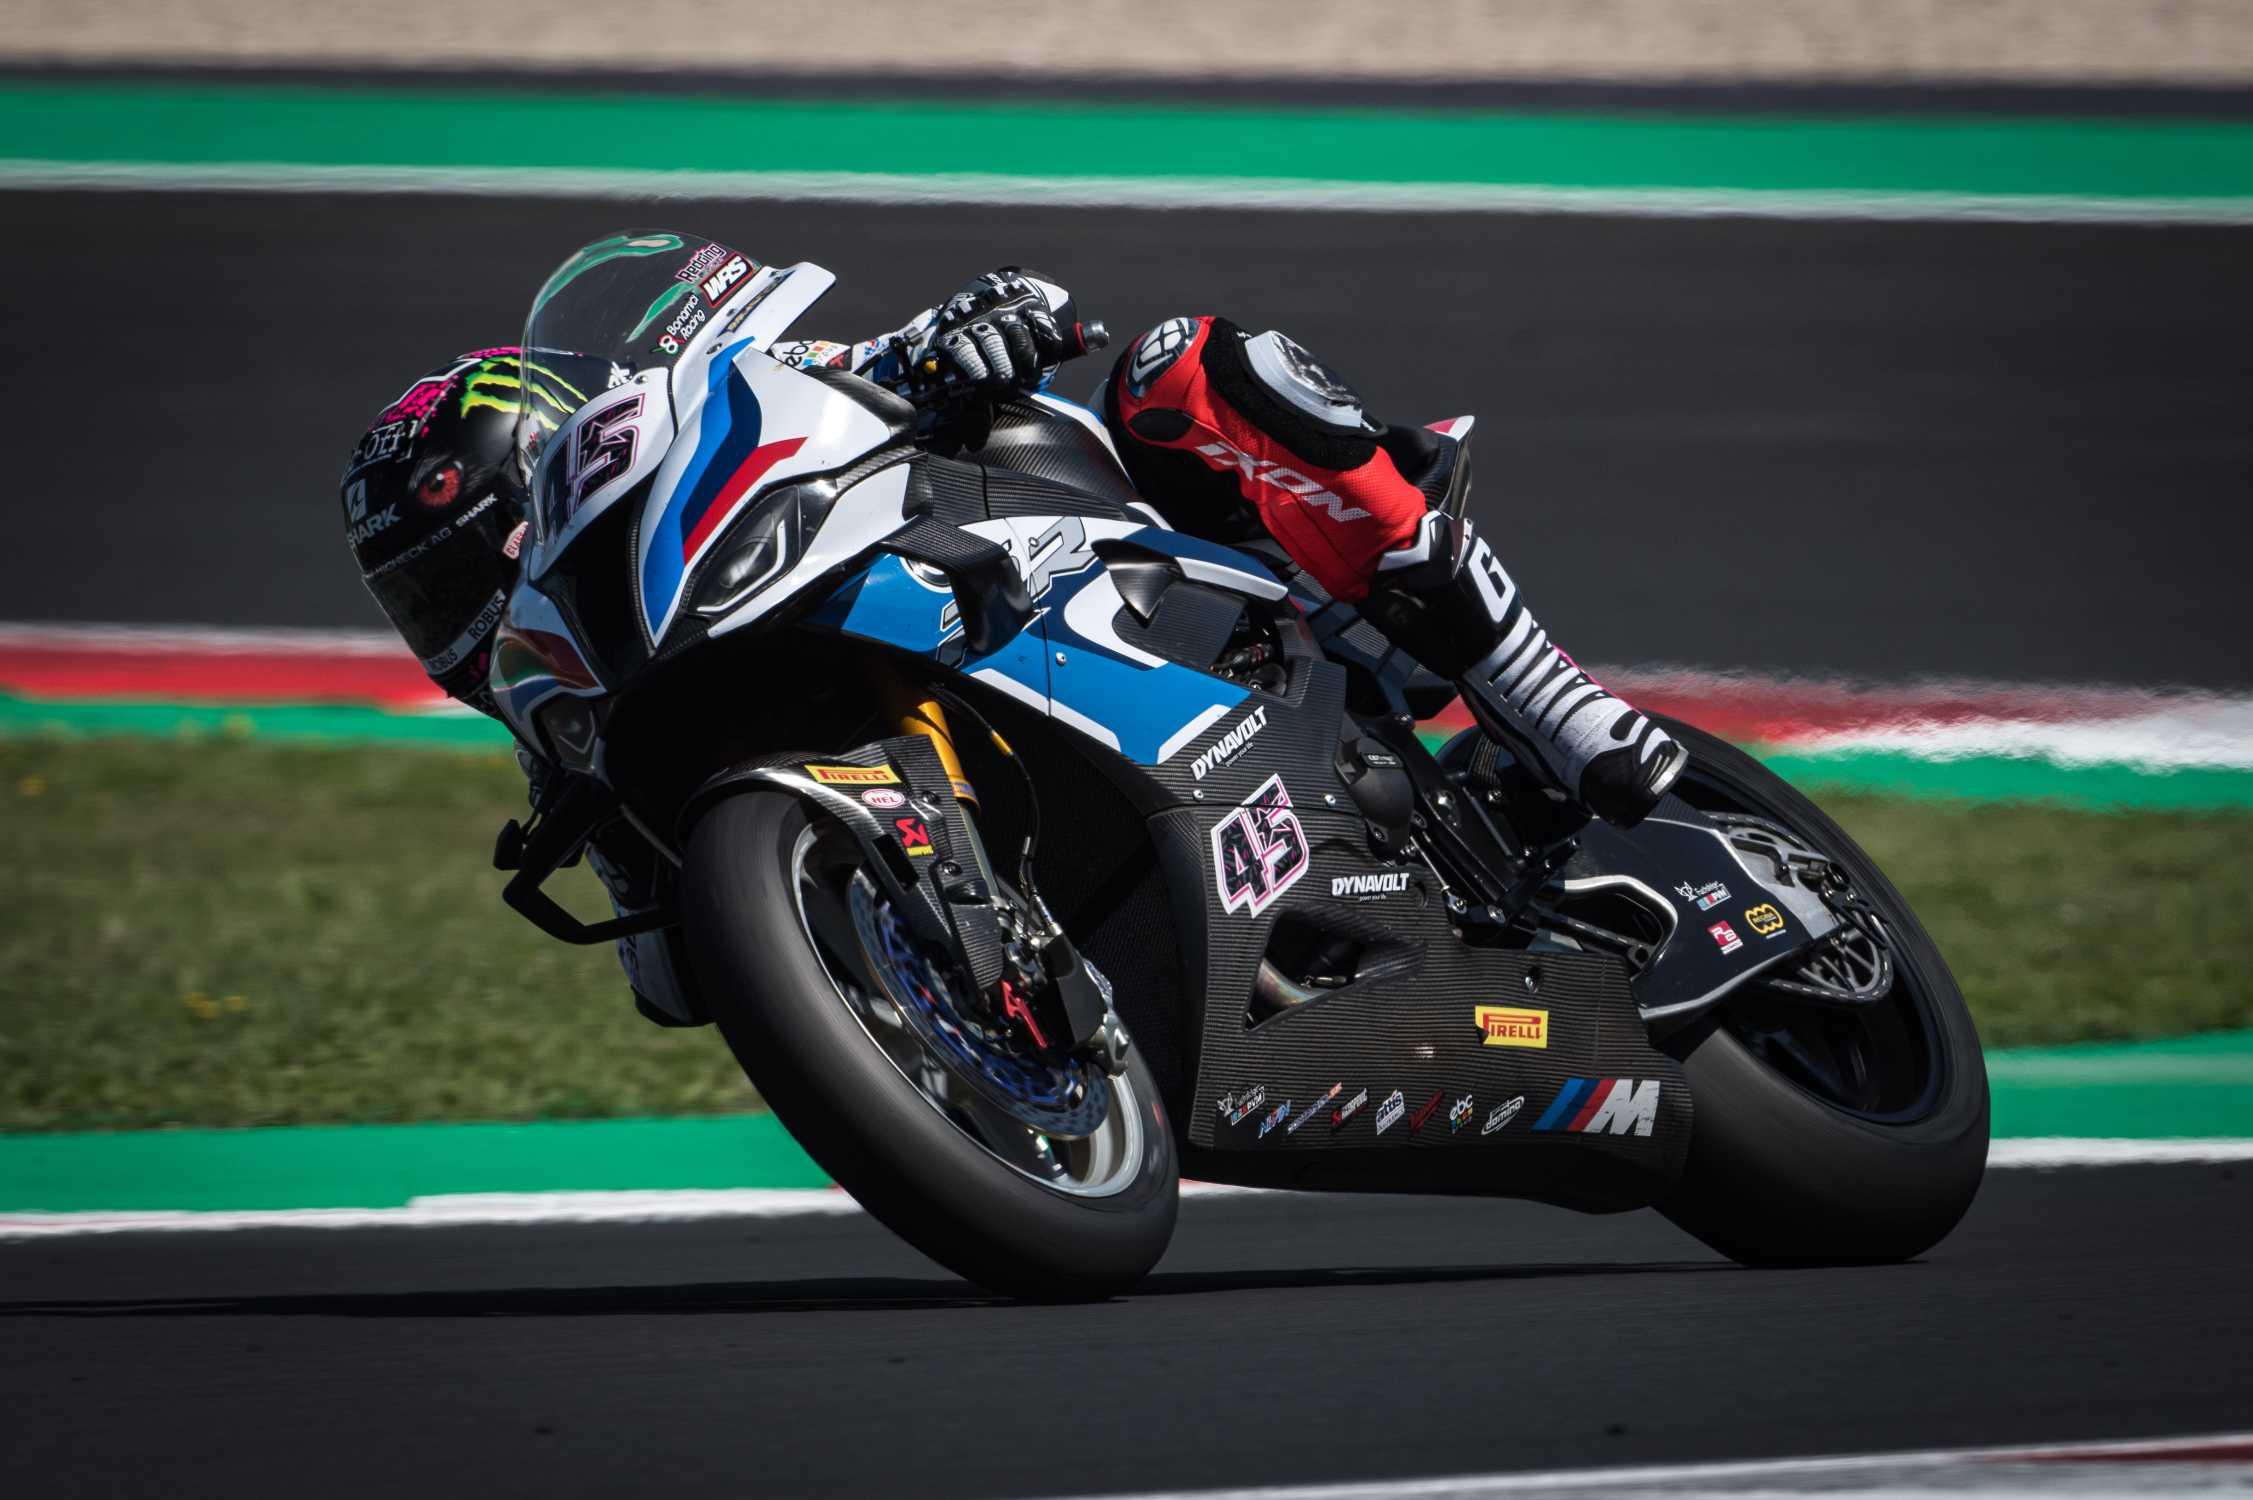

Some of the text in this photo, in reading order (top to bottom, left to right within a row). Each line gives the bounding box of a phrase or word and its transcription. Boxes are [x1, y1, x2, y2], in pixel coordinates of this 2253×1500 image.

[1195, 441, 1372, 522] IXON
[1190, 706, 1267, 780] DYNAVOLT
[817, 768, 889, 781] PIRELLI
[1213, 775, 1307, 914] 45
[1332, 873, 1409, 896] DYNAVOLT
[1482, 1013, 1541, 1040] PIRELLI
